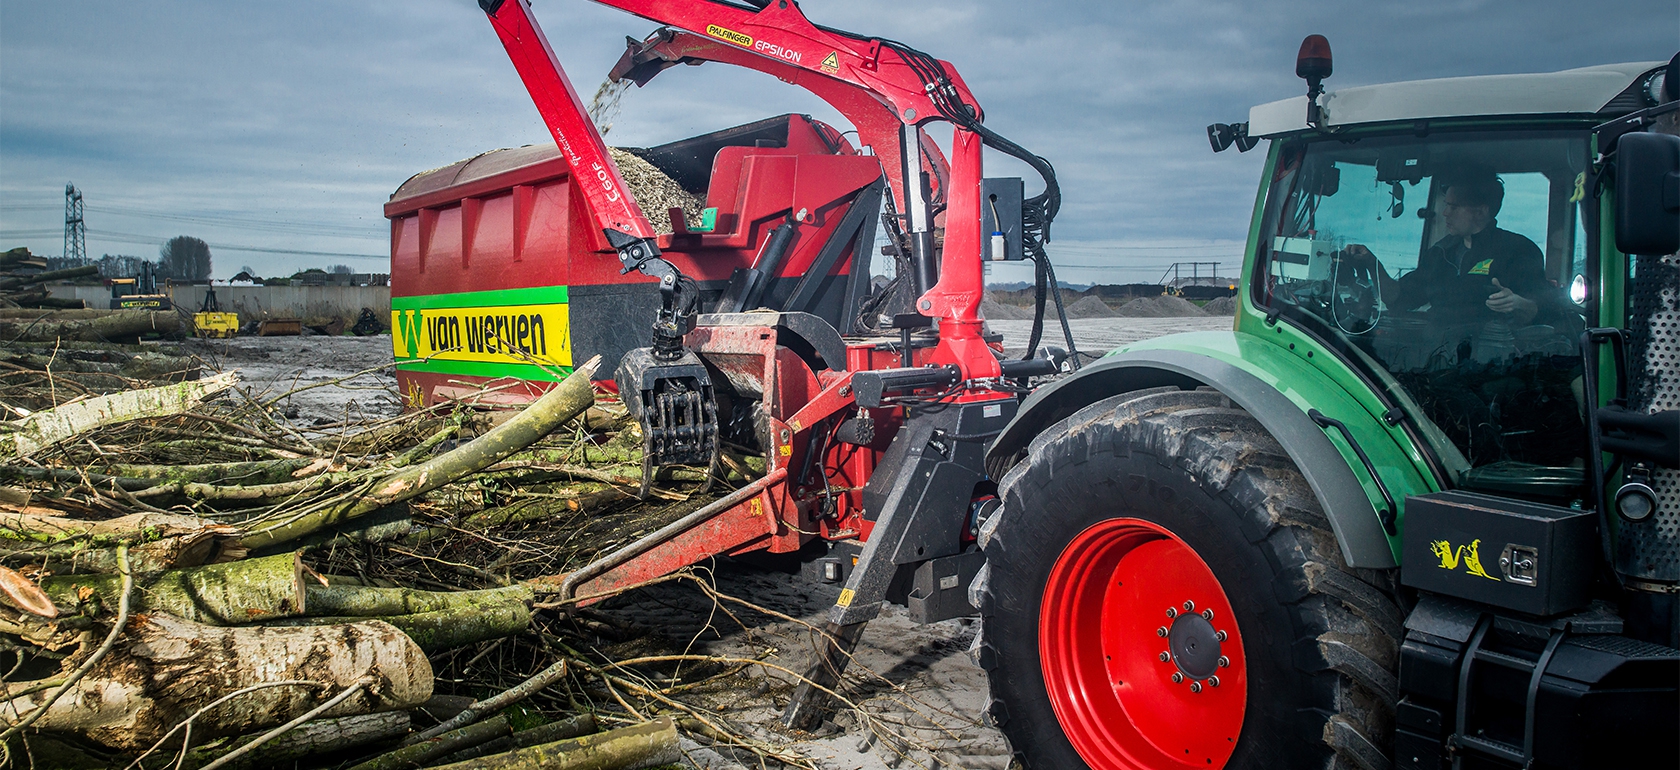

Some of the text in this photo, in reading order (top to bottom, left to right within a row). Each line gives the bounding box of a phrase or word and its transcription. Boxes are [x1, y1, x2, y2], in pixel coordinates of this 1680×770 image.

[708, 25, 751, 46] PALFINGER
[755, 40, 801, 62] EPSILON
[427, 315, 463, 353] van
[465, 313, 546, 355] werven
